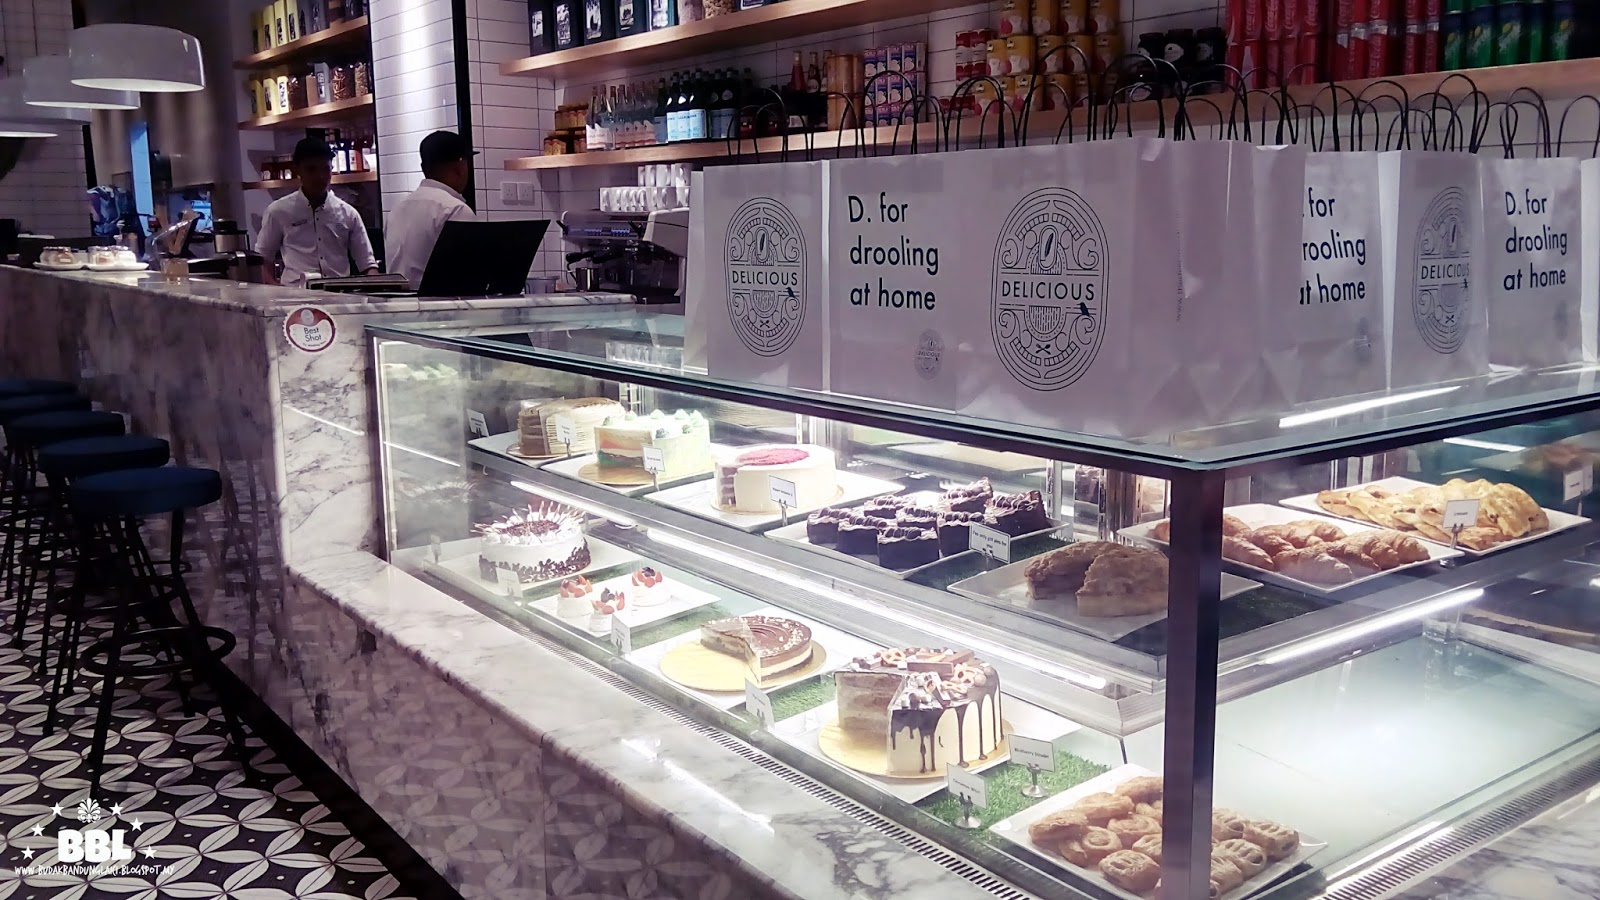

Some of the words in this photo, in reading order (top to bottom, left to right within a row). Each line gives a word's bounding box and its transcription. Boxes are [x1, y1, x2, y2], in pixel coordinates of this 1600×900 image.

[848, 195, 871, 222] D.
[880, 191, 908, 222] for
[1308, 187, 1335, 217] for
[1505, 191, 1522, 215] D.
[1526, 188, 1547, 214] for
[1302, 229, 1366, 265] rooling
[1505, 224, 1567, 255] drooling
[850, 235, 938, 275] drooling
[732, 270, 798, 286] DELICIOUS
[1002, 281, 1095, 301] DELICIOUS
[1316, 273, 1366, 303] home
[1503, 269, 1522, 291] at
[1530, 262, 1566, 288] home
[850, 283, 870, 306] at
[878, 277, 936, 311] home
[304, 327, 319, 335] Best
